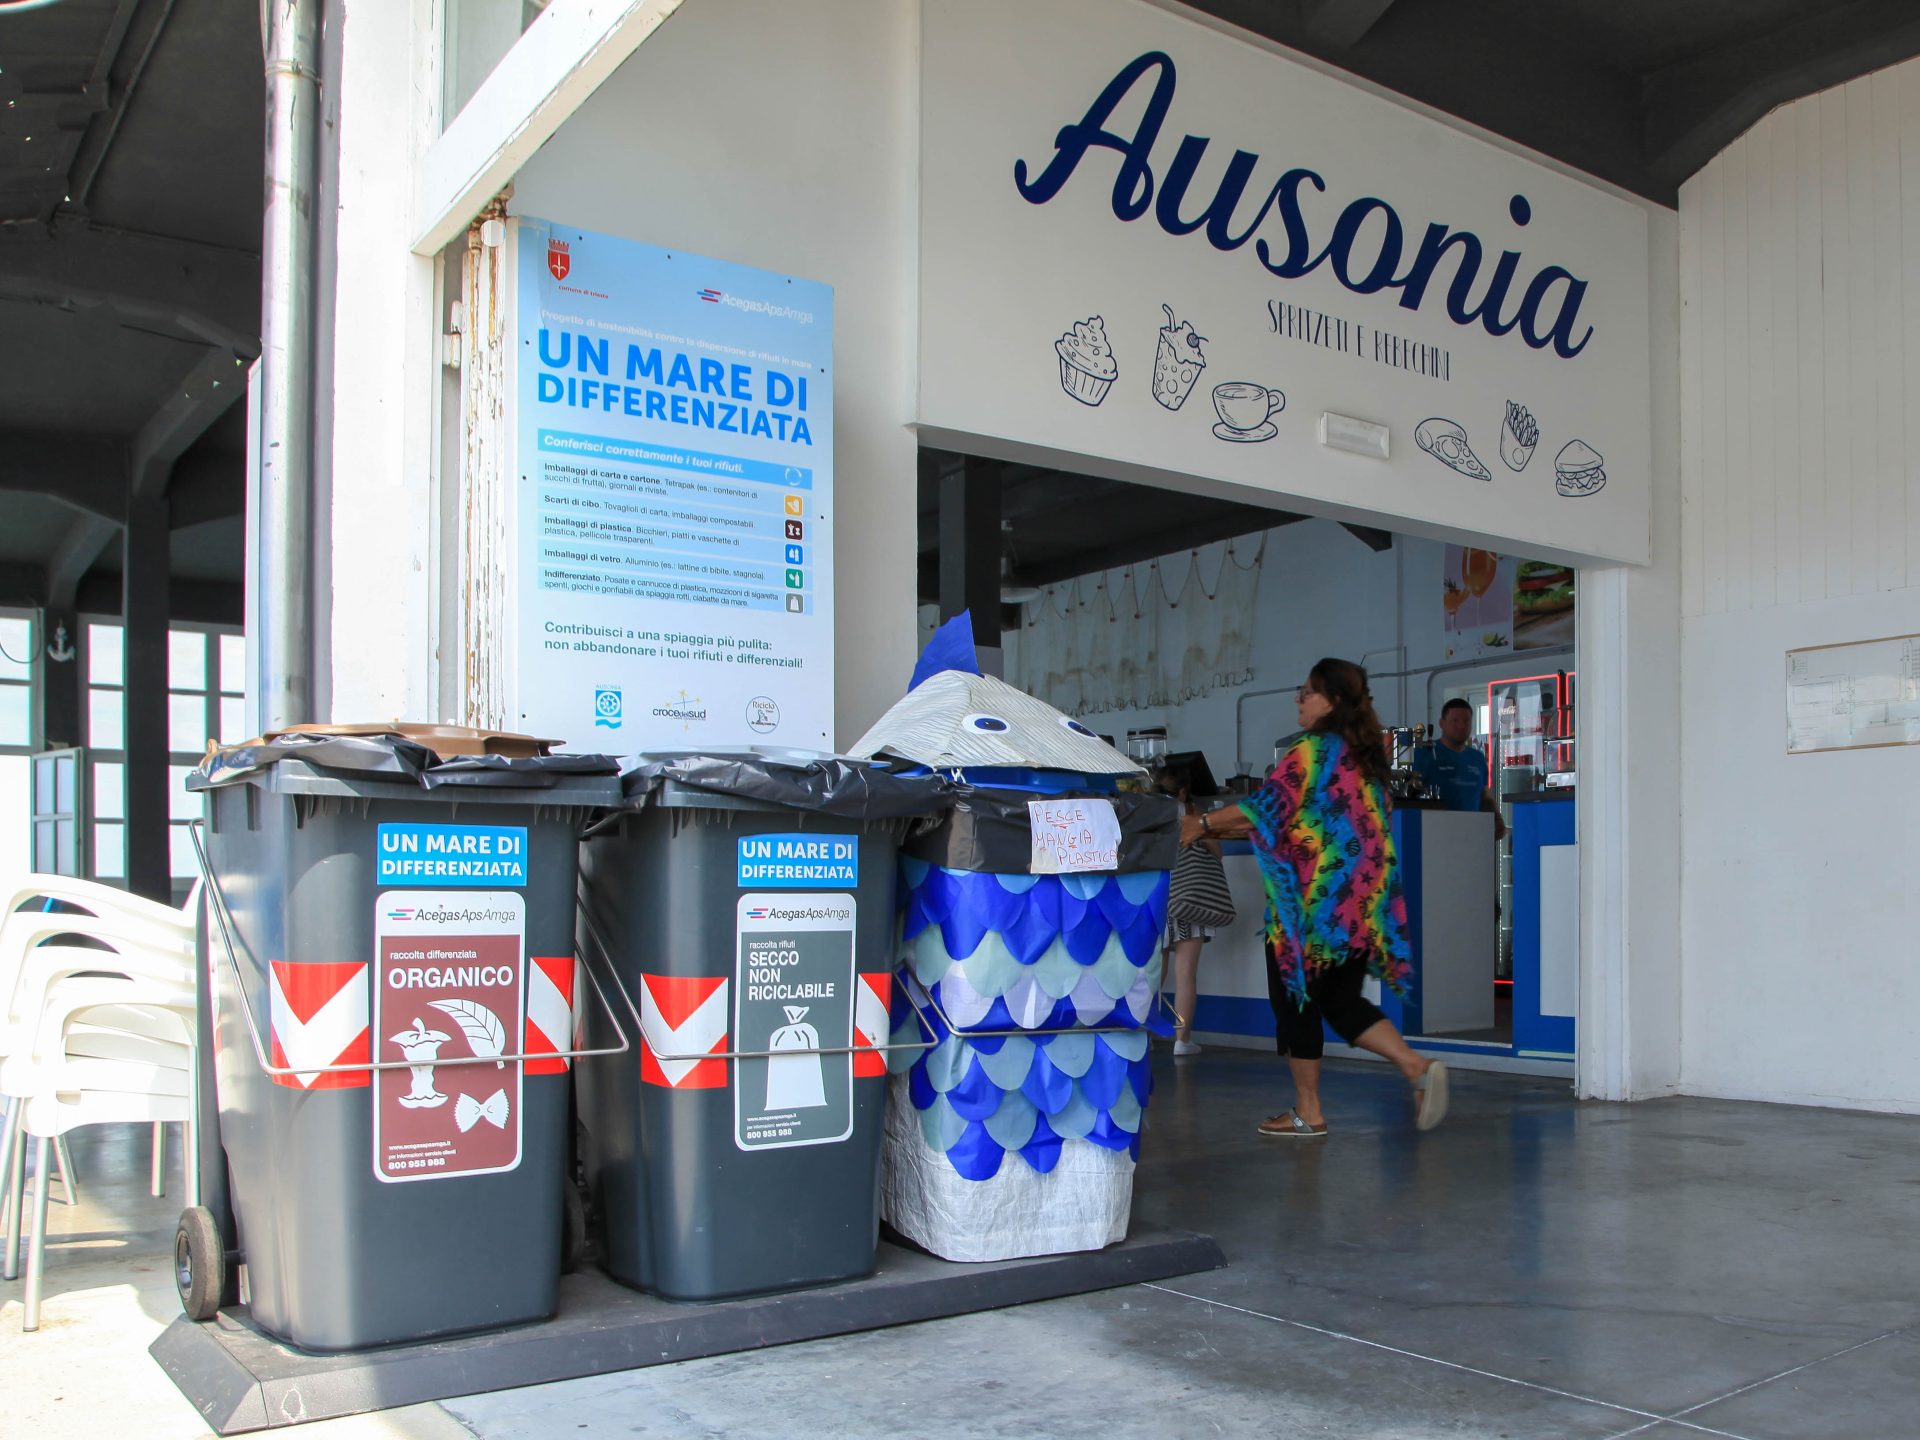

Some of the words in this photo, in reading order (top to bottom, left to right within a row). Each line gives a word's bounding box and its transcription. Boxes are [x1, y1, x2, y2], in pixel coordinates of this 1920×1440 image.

[1013, 50, 1594, 359] Ausonia
[721, 293, 813, 324] AcegasApsAmga
[542, 309, 583, 325] Progetto
[586, 318, 595, 328] di
[655, 332, 684, 344] contro
[687, 337, 695, 346] la
[696, 338, 746, 357] dispersione
[748, 350, 757, 358] di
[758, 351, 780, 361] rifiuti
[782, 355, 790, 364] in
[792, 359, 812, 368] mare
[1267, 299, 1348, 352] SPRITZETI
[1357, 325, 1365, 358] E
[1374, 330, 1449, 381] REBECHINI
[539, 329, 608, 376] UN
[626, 344, 752, 401] MARE
[767, 371, 806, 411] DI
[538, 373, 812, 446] DIFFERENZIATA
[544, 435, 603, 452] Conferisci
[606, 445, 683, 464] correttamente
[686, 456, 690, 465] i
[692, 457, 712, 468] tuoi
[714, 459, 744, 473] rifiuti.
[544, 463, 588, 477] Imballaggi
[590, 468, 598, 476] di
[600, 471, 620, 479] carta
[630, 474, 662, 485] cartone.
[665, 478, 695, 490] Tetrapak
[713, 487, 749, 498] contenitori
[544, 474, 571, 483] succhi
[572, 476, 580, 484] di
[609, 481, 637, 492] giornali
[645, 486, 668, 496] riviste.
[544, 495, 570, 505] Scarti
[581, 499, 601, 508] cibo.
[604, 501, 639, 513] Tovaglioli
[641, 506, 648, 514] di
[649, 508, 670, 518] carta,
[672, 511, 708, 523] imballaggi
[544, 516, 588, 528] Imballaggi
[590, 521, 598, 529] di
[600, 523, 634, 533] plastica.
[636, 527, 670, 538] Bicchieri,
[672, 531, 690, 540] piatti
[697, 536, 731, 545] vaschette
[544, 527, 578, 537] plastica,
[580, 529, 612, 540] pellicole
[613, 533, 655, 545] trasparenti.
[544, 549, 588, 561] Imballaggi
[590, 553, 598, 561] di
[600, 555, 623, 563] vetro.
[625, 557, 659, 568] Alluminio
[677, 564, 699, 572] lattine
[710, 567, 731, 576] bibite,
[544, 581, 570, 591] spenti,
[571, 582, 593, 592] giochi
[602, 585, 633, 595] gonfiabili
[646, 590, 675, 600] spiaggia
[676, 593, 691, 601] rotti,
[693, 594, 719, 603] ciabatte
[604, 575, 629, 585] Posate
[637, 580, 671, 589] cannucce
[673, 582, 680, 590] di
[680, 584, 709, 593] plastica,
[709, 587, 742, 597] mozziconi
[752, 592, 778, 601] sigaretta
[544, 621, 623, 638] Contribuisci
[627, 630, 634, 639] a
[638, 631, 660, 641] una
[664, 632, 714, 646] spiaggia
[717, 636, 735, 648] più
[738, 639, 772, 651] pulita:
[544, 640, 569, 650] non
[573, 641, 656, 657] abbandonare
[660, 647, 663, 657] i
[667, 647, 690, 659] tuoi
[693, 649, 723, 662] rifiuti
[726, 654, 733, 662] e
[737, 653, 803, 668] differenziali!
[1034, 803, 1085, 823] PESCE
[382, 833, 418, 853] UN
[426, 834, 491, 854] MARE
[497, 836, 520, 855] DI
[1036, 829, 1092, 847] MANGIA
[742, 841, 771, 858] UN
[777, 841, 829, 860] MARE
[834, 843, 852, 860] DI
[1057, 847, 1117, 865] PLASTICA
[382, 860, 522, 876] DIFFERENZIATA
[742, 864, 854, 879] DIFFERENZIATA
[415, 908, 516, 924] AcegasApsAmga
[768, 908, 850, 921] AcegasApsAmga
[390, 950, 425, 959] raccolta
[426, 949, 477, 959] differenziata
[749, 940, 777, 949] raccolta
[779, 939, 796, 948] rifiuti
[749, 950, 800, 967] SECCO
[388, 965, 514, 989] ORGANICO
[749, 968, 781, 983] NON
[749, 983, 835, 1000] RICICLABILE
[747, 1131, 761, 1139] 800
[762, 1130, 777, 1138] 955
[389, 1161, 407, 1170] 800
[408, 1160, 426, 1168] 955
